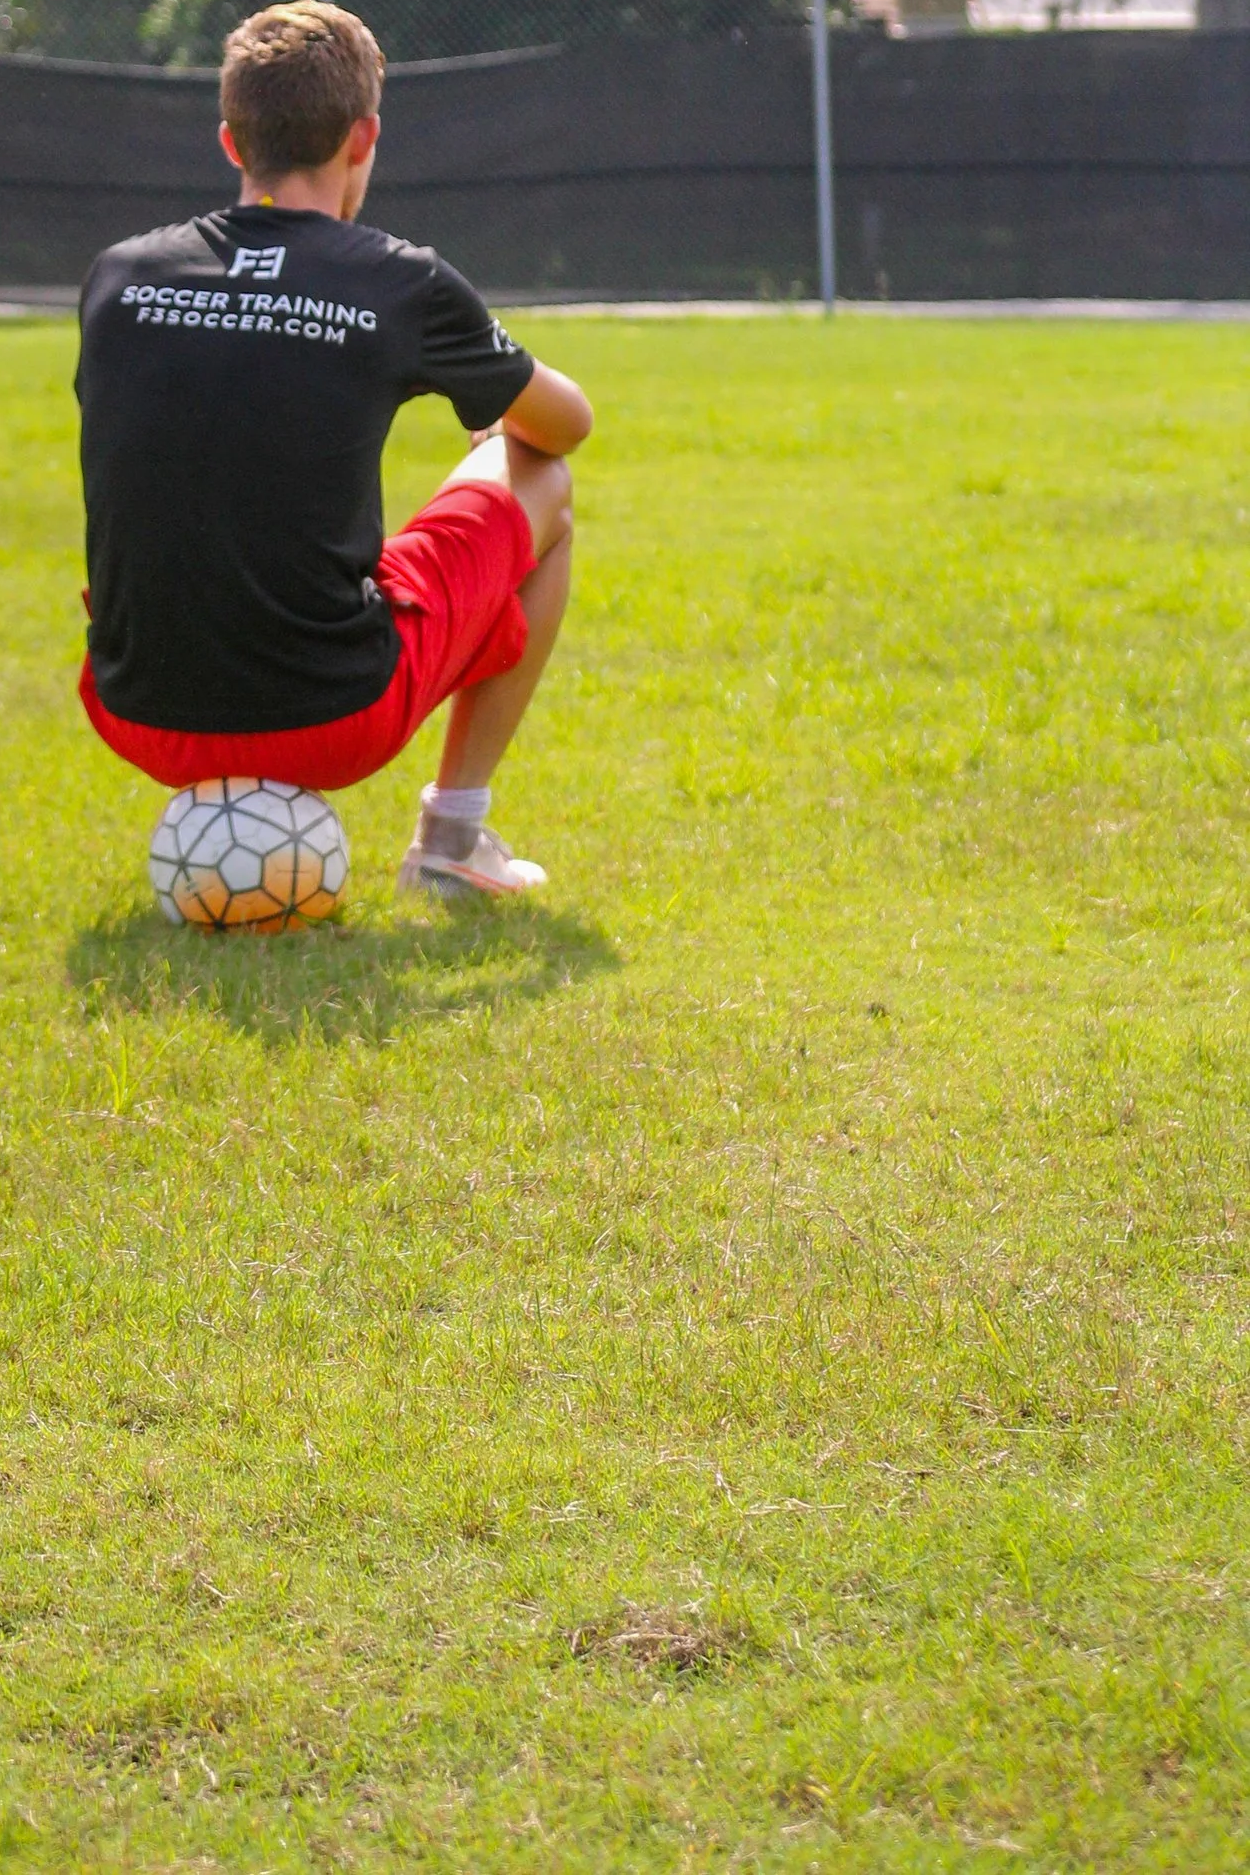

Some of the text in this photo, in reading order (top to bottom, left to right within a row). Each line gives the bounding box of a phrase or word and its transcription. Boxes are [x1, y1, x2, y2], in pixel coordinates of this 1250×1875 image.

[120, 285, 377, 332] SOCCER TRAINING
[136, 306, 347, 345] F3SOCCER.COM
